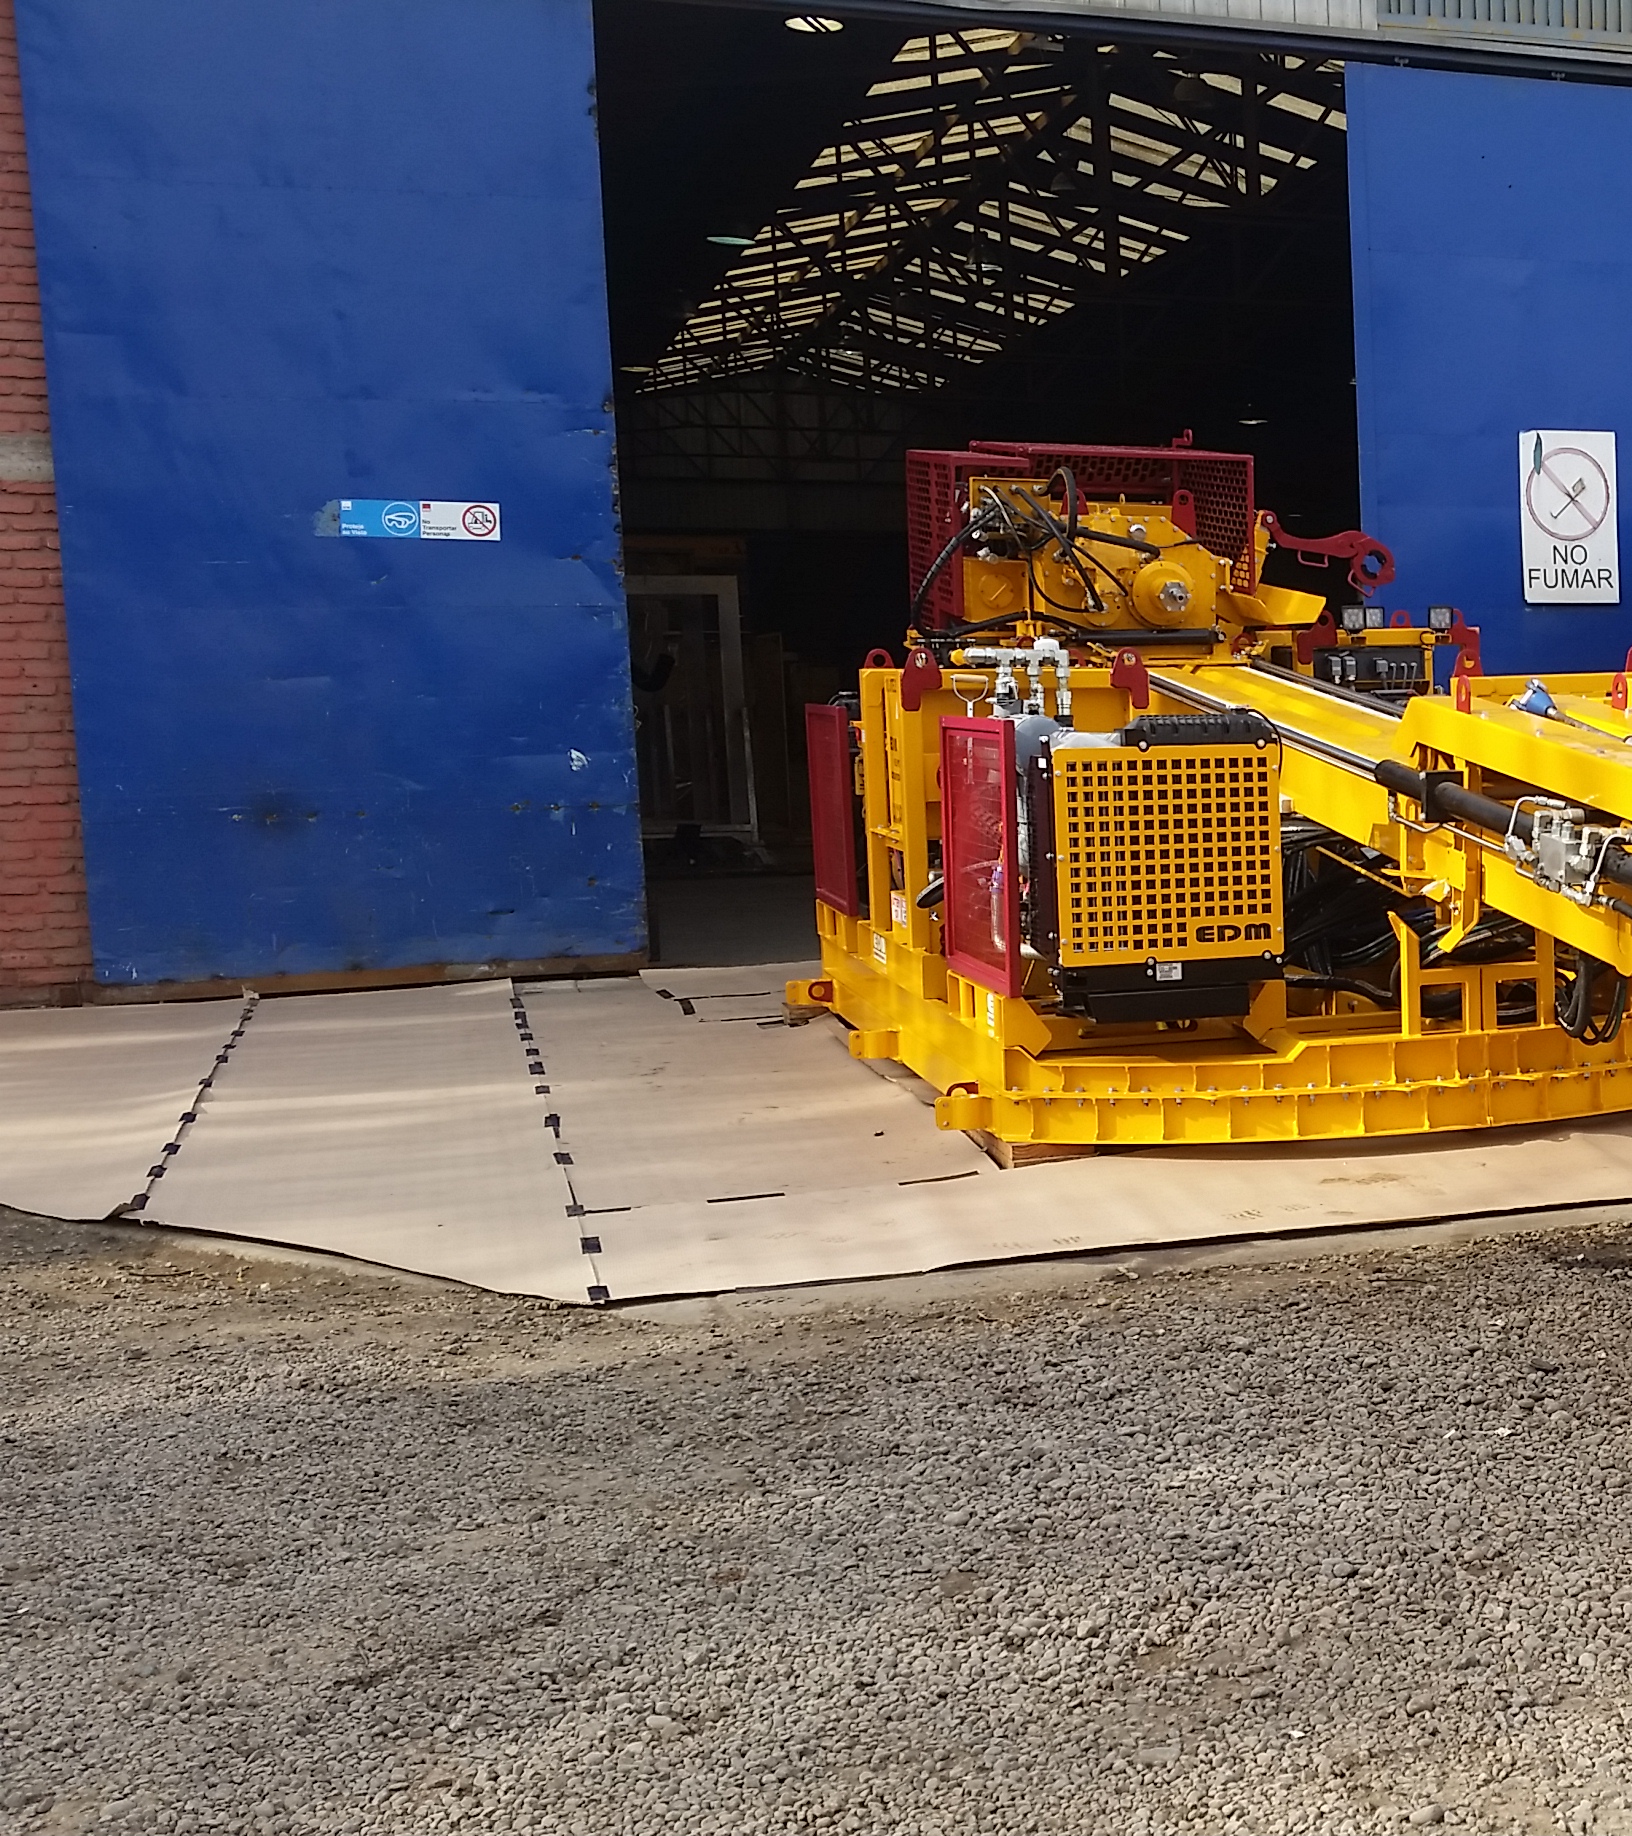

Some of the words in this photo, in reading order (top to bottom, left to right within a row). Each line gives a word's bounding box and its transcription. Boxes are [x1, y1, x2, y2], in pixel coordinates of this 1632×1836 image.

[1552, 544, 1588, 565] NO
[1528, 568, 1614, 589] FUMAR
[1195, 922, 1273, 943] EDM
